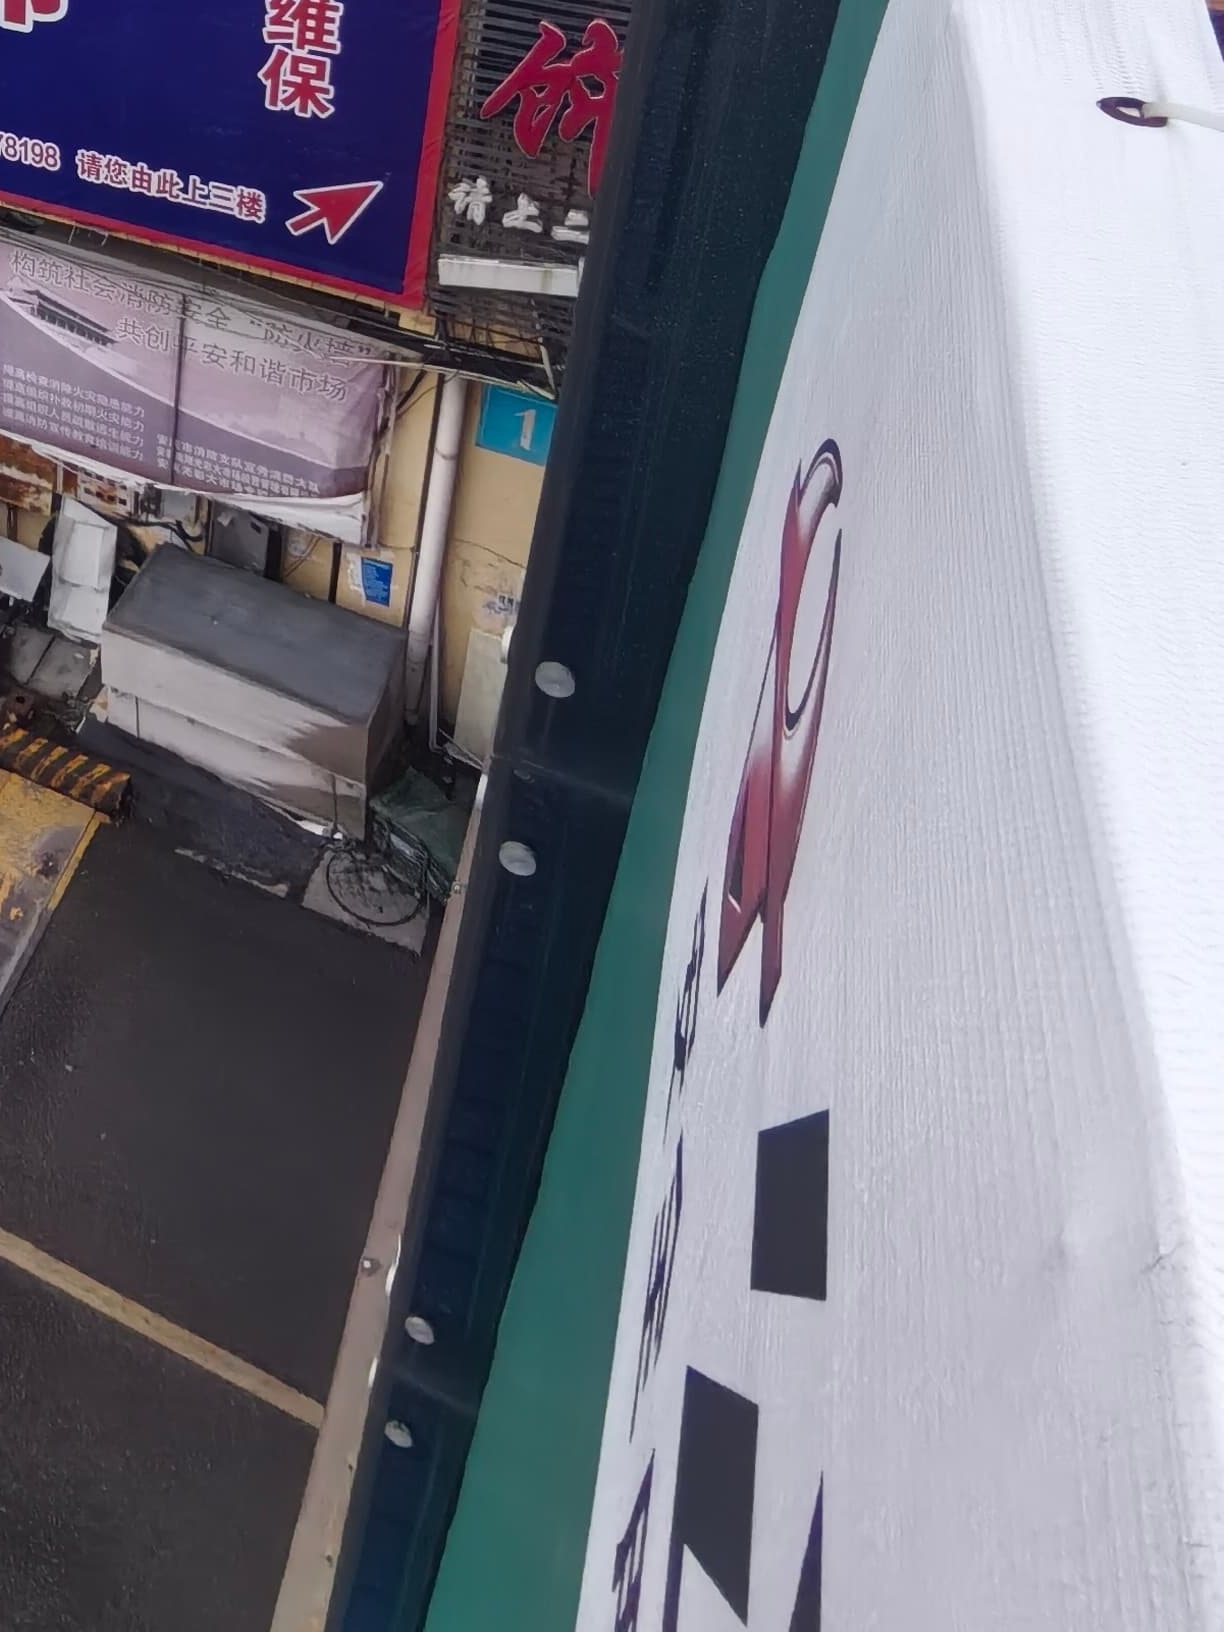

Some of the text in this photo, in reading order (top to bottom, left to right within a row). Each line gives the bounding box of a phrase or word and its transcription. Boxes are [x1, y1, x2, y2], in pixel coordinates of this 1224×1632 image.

[76, 148, 268, 225] 请您由此上三楼
[116, 317, 349, 402] 共创平安和谐市场
